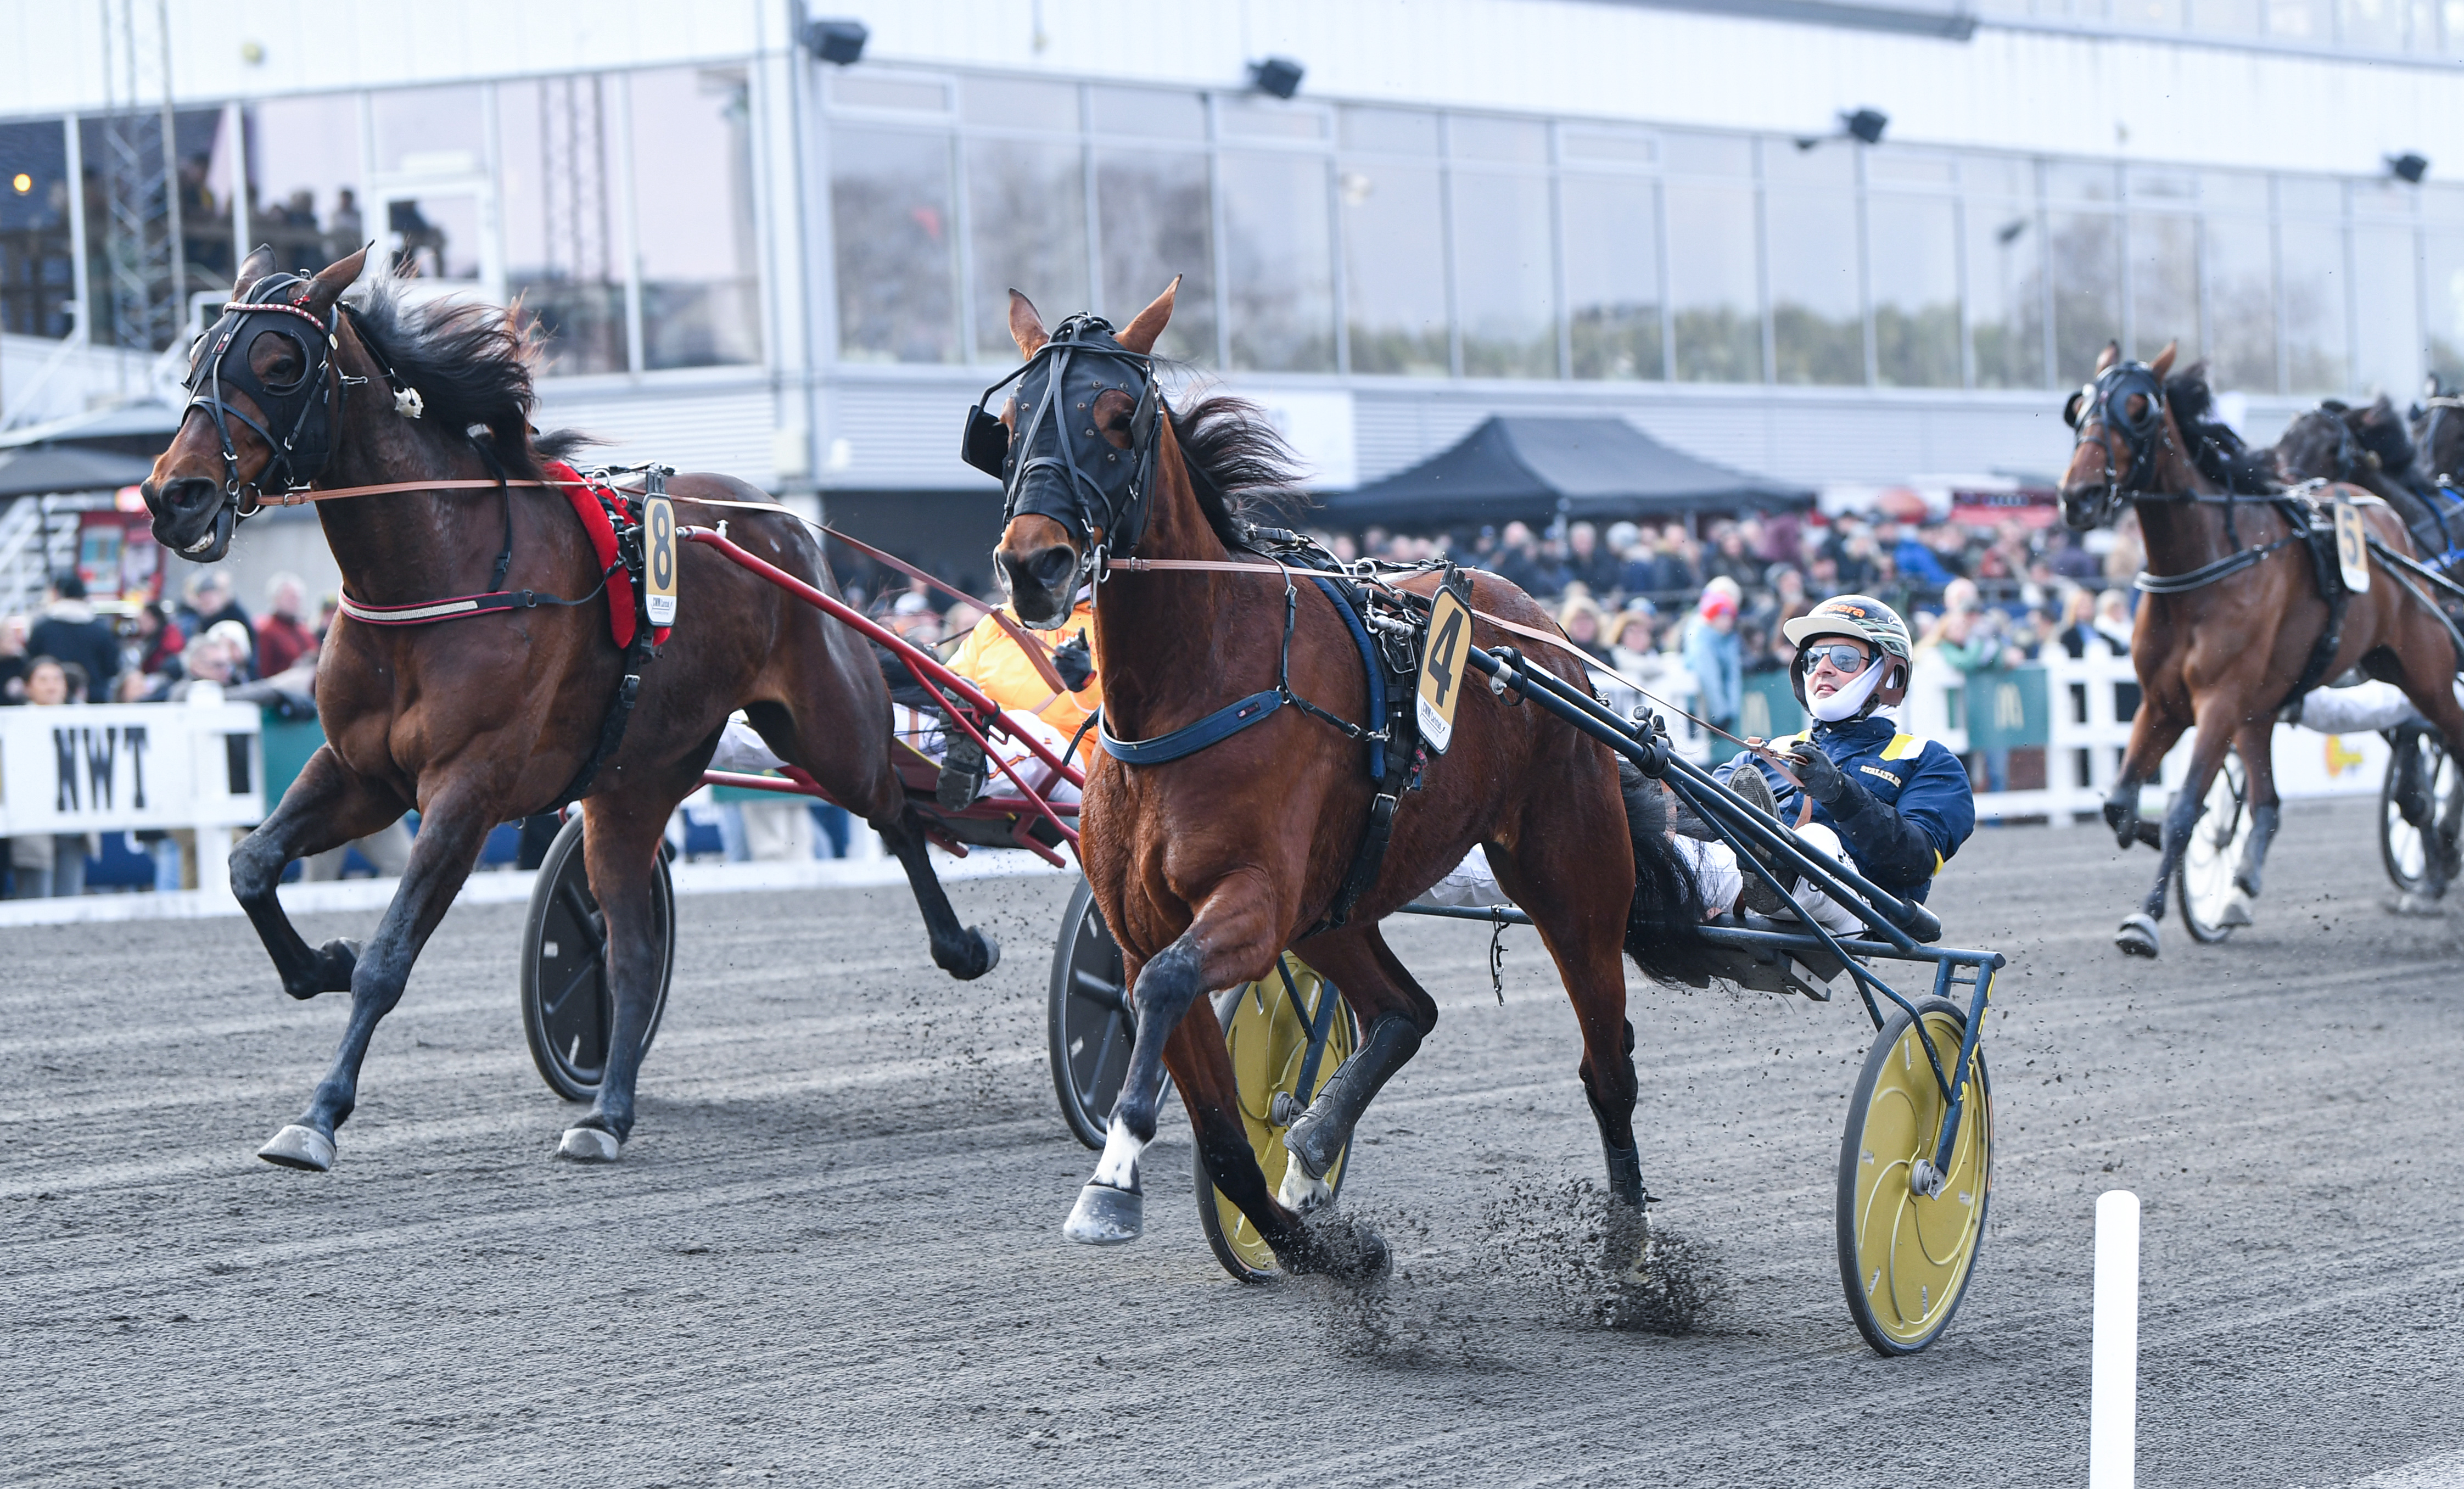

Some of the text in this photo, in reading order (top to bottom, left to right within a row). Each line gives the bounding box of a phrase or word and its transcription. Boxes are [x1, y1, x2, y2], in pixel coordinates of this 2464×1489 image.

[653, 502, 671, 590] 8
[2343, 509, 2359, 566] 5
[1823, 603, 1866, 618] ssera
[1427, 607, 1464, 708] 4
[54, 726, 148, 811] NWT
